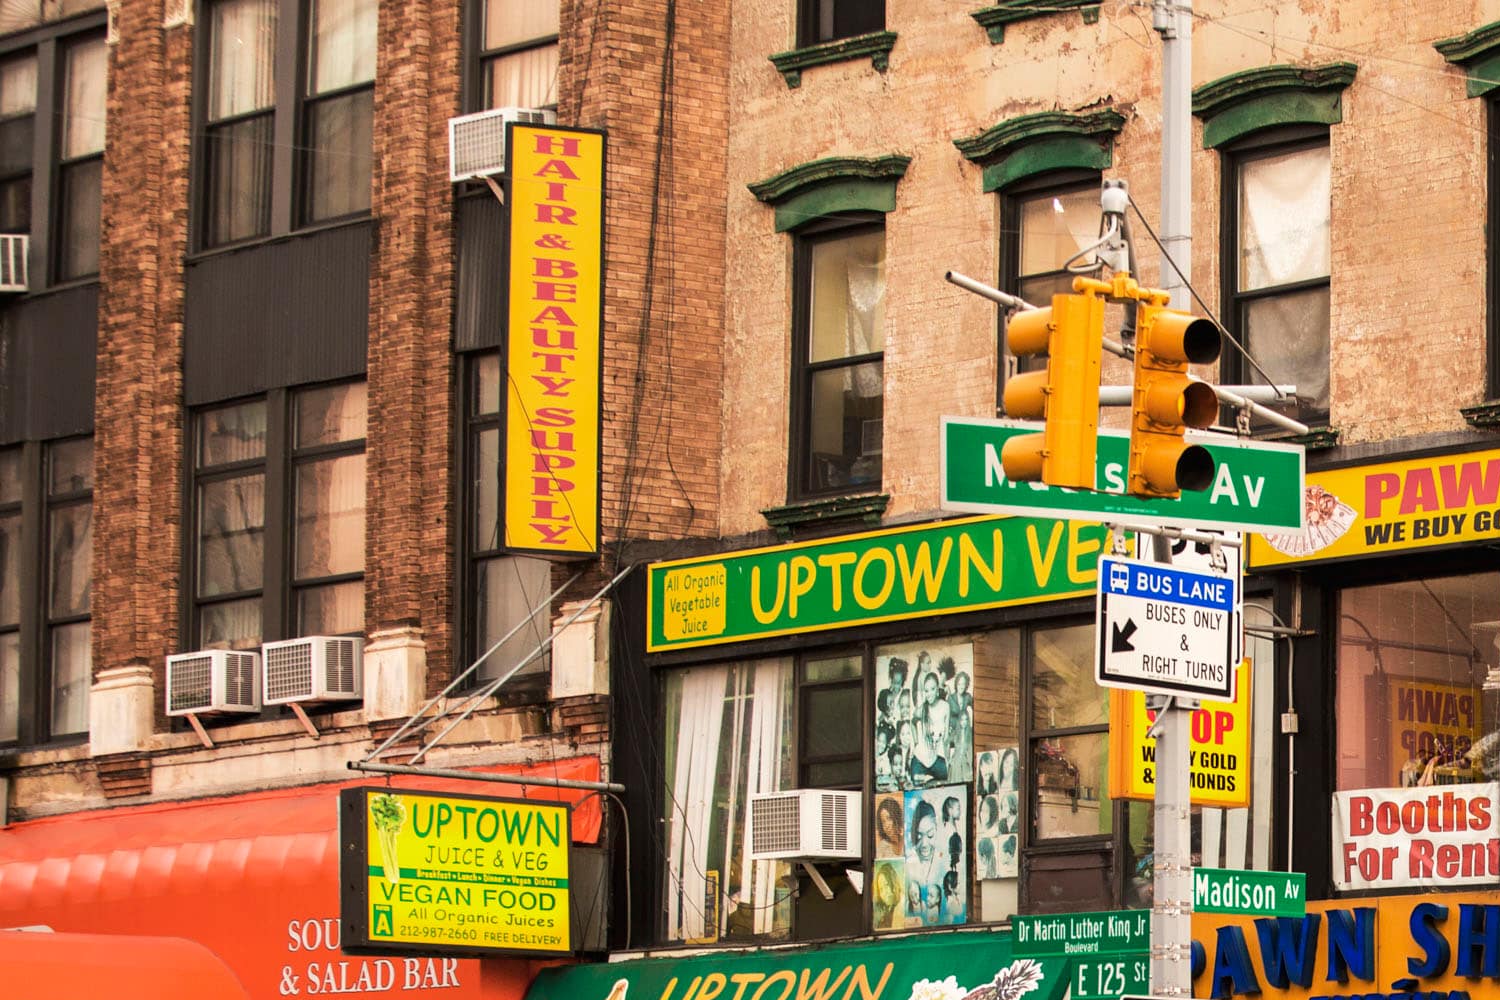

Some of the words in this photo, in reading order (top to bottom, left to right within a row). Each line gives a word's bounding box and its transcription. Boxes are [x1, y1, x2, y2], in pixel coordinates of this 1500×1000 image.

[533, 134, 582, 226] HAIR
[534, 234, 576, 250] &
[530, 257, 579, 397] BEAUTY
[528, 407, 577, 545] SUPPLY
[1210, 463, 1265, 508] Av
[1364, 521, 1405, 546] WE
[1413, 513, 1468, 540] BUY
[665, 573, 679, 592] All
[683, 571, 725, 594] Organic
[751, 529, 1004, 624] UPTOWN
[1026, 519, 1112, 588] VE
[1137, 572, 1172, 595] BUS
[1178, 578, 1226, 604] LANE
[669, 591, 720, 615] Vegetable
[1146, 603, 1187, 625] BUSES
[1193, 611, 1222, 631] ONLY
[681, 617, 708, 635] Juice
[1180, 634, 1189, 651] &
[1142, 654, 1177, 676] RIGHT
[1186, 660, 1225, 682] TURNS
[1200, 752, 1237, 771] GOLD
[413, 802, 560, 847] UPTOWN
[1350, 792, 1492, 837] Booths
[425, 845, 484, 867] JUICE
[493, 851, 504, 868] &
[512, 852, 548, 870] VEG
[1343, 843, 1399, 883] For
[381, 883, 471, 906] VEGAN
[484, 890, 556, 911] FOOD
[1195, 874, 1276, 910] Madison
[1284, 879, 1299, 899] Av
[376, 912, 391, 935] A
[408, 908, 427, 920] All
[434, 909, 498, 926] Organic
[506, 913, 555, 928] Juices
[1019, 921, 1030, 942] Dr
[1034, 917, 1066, 941] Martin
[1070, 916, 1104, 939] Luther
[1108, 914, 1130, 943] King
[1134, 919, 1146, 937] Jr
[400, 926, 477, 941] 212-987-2660
[484, 932, 509, 943] FREE
[512, 934, 562, 945] DELIVERY
[1065, 941, 1099, 953] Boulevard
[279, 966, 299, 996] &
[307, 959, 395, 995] SALAD
[402, 957, 461, 991] BAR
[1078, 964, 1088, 995] E
[1097, 963, 1125, 994] 125
[1134, 962, 1146, 983] St
